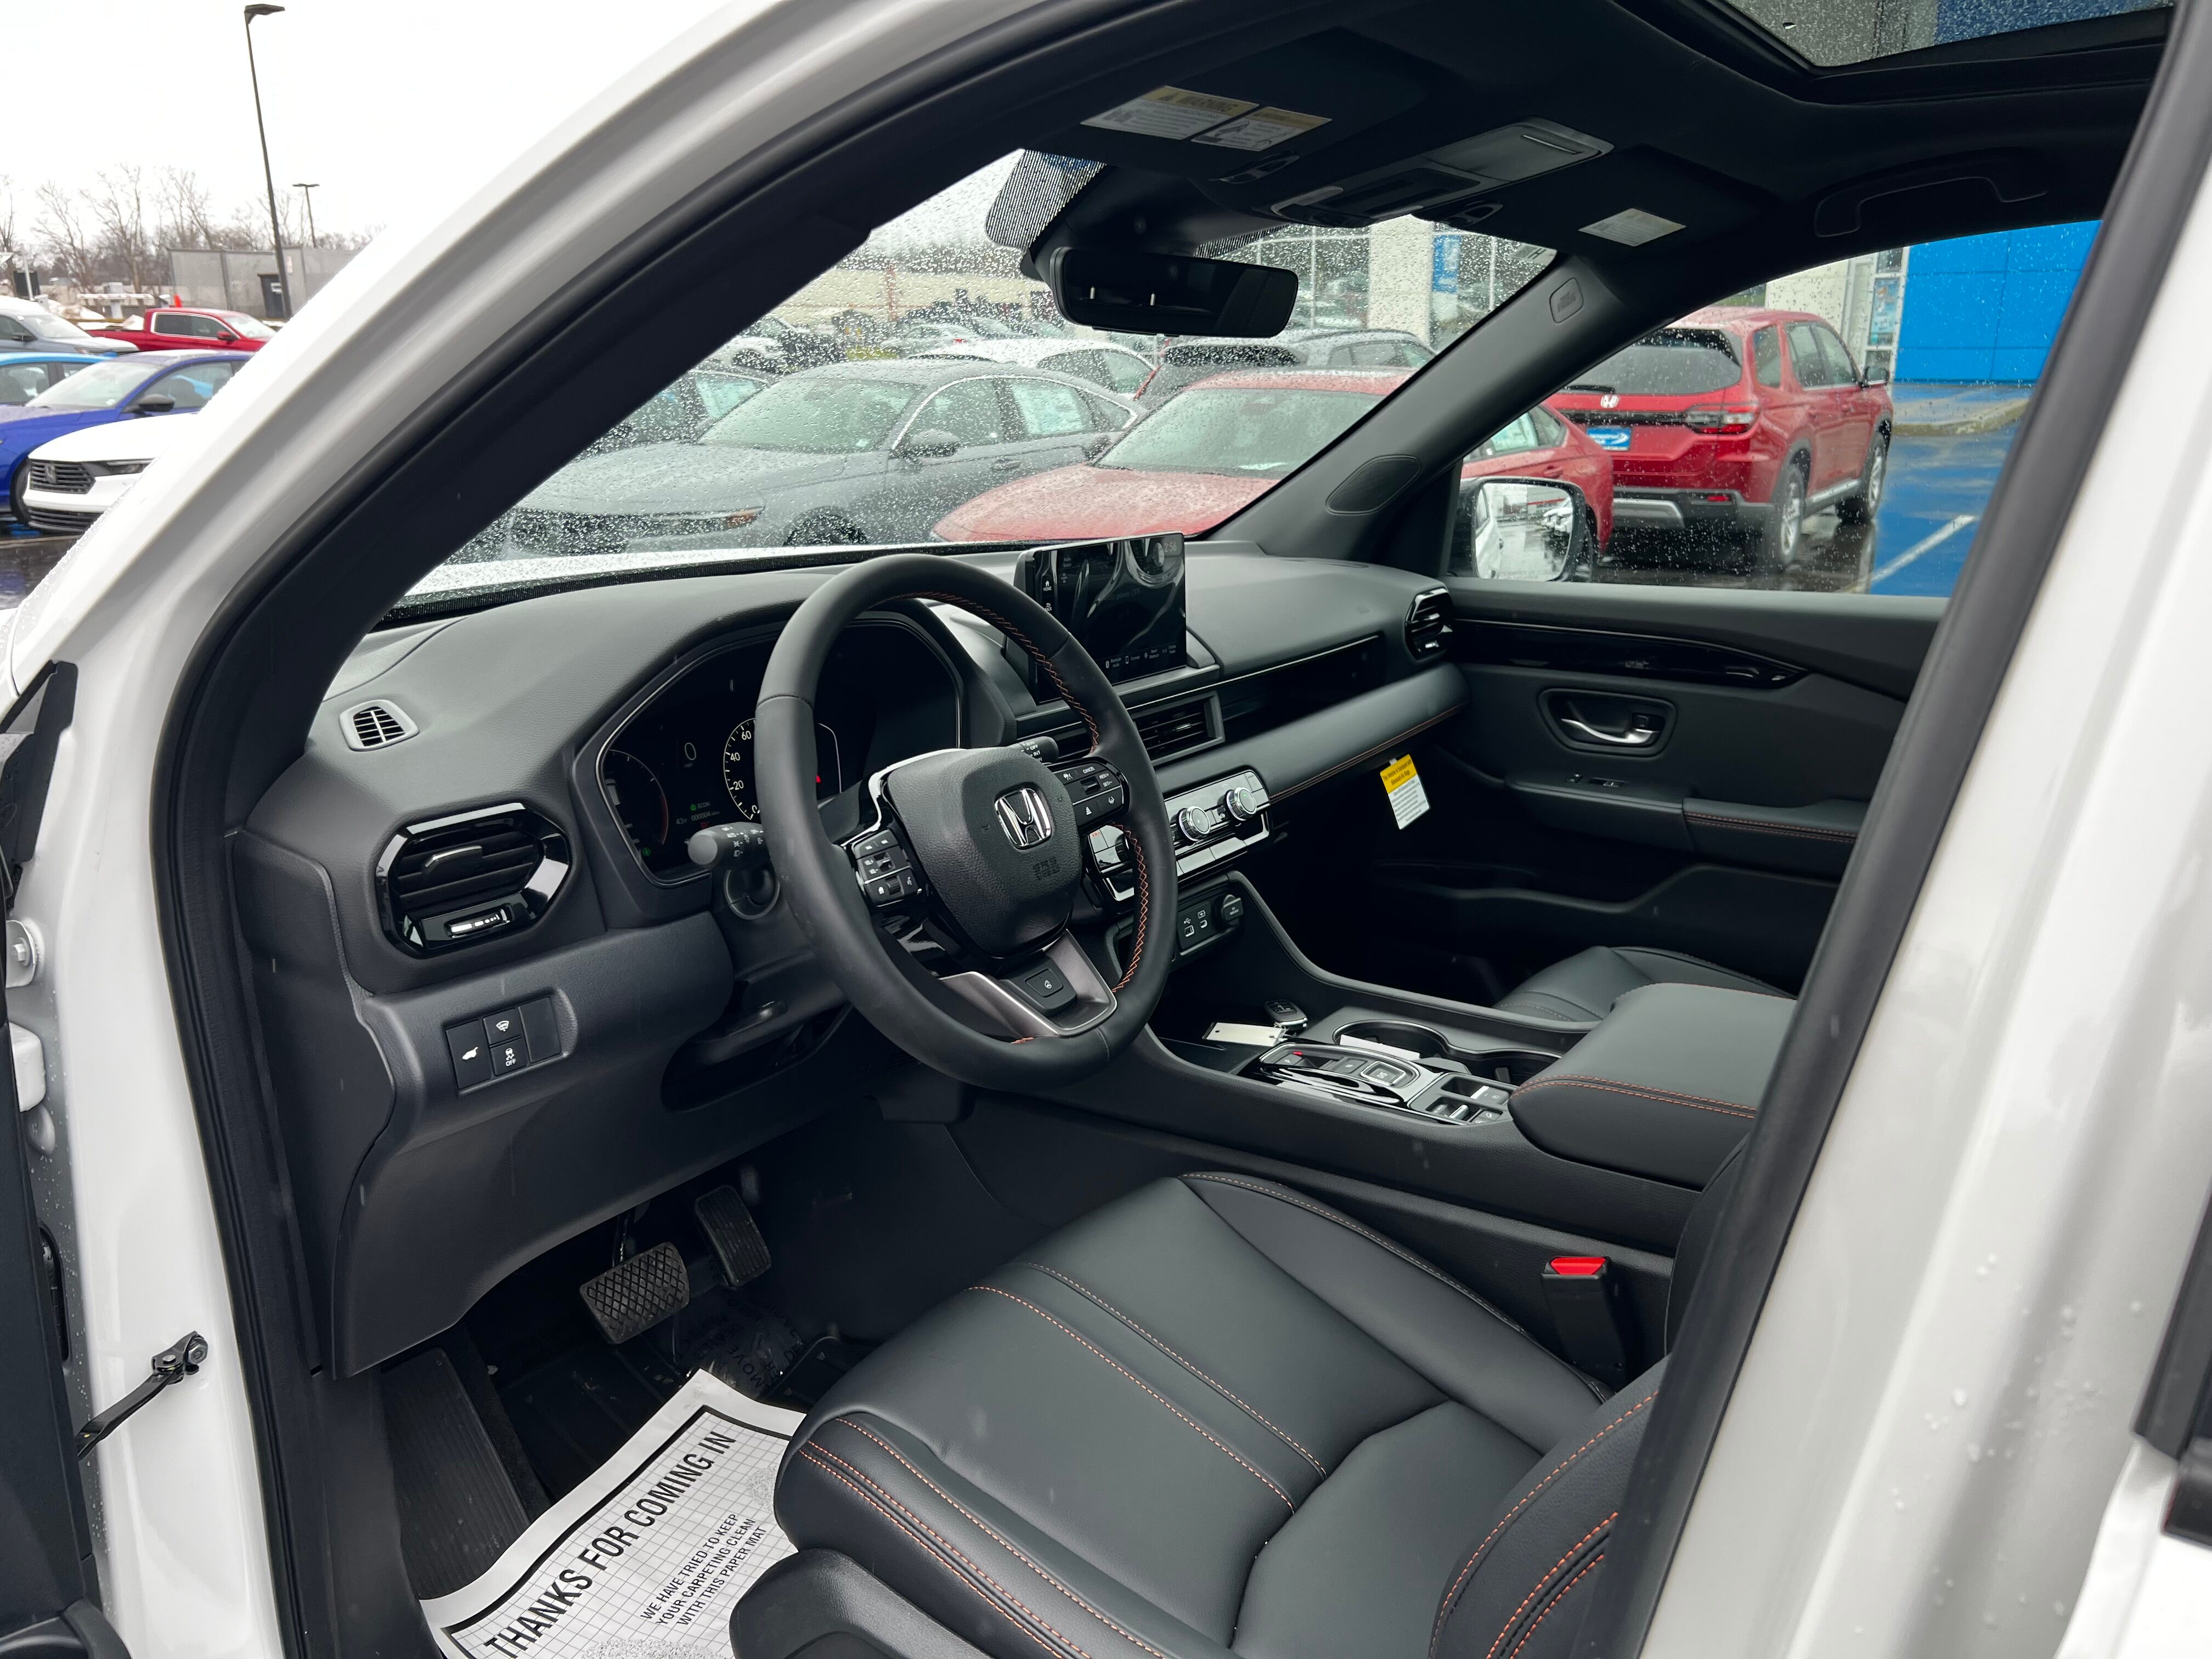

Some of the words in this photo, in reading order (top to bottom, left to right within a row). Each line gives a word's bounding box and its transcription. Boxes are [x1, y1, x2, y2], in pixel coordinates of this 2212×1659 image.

[1164, 543, 1177, 552] 2:56
[741, 730, 752, 741] 60
[684, 742, 697, 760] 0
[730, 752, 741, 761] 40
[733, 780, 744, 790] 20
[505, 1058, 516, 1067] OFF
[484, 1569, 592, 1658] THANKS
[578, 1526, 640, 1571] FOR
[624, 1454, 714, 1527] COMING
[698, 1431, 736, 1454] IN
[640, 1602, 662, 1619] WE
[656, 1578, 685, 1602] HAVE
[678, 1550, 708, 1576] TRIED
[703, 1537, 720, 1549] TO
[719, 1514, 738, 1536] KEEP
[656, 1599, 686, 1624] YOUR
[682, 1548, 731, 1597] CARPETING
[726, 1519, 756, 1546] CLEAN
[676, 1601, 706, 1625] WITH
[699, 1578, 724, 1598] THIS
[720, 1548, 751, 1577] PAPER
[746, 1527, 766, 1546] MAT
